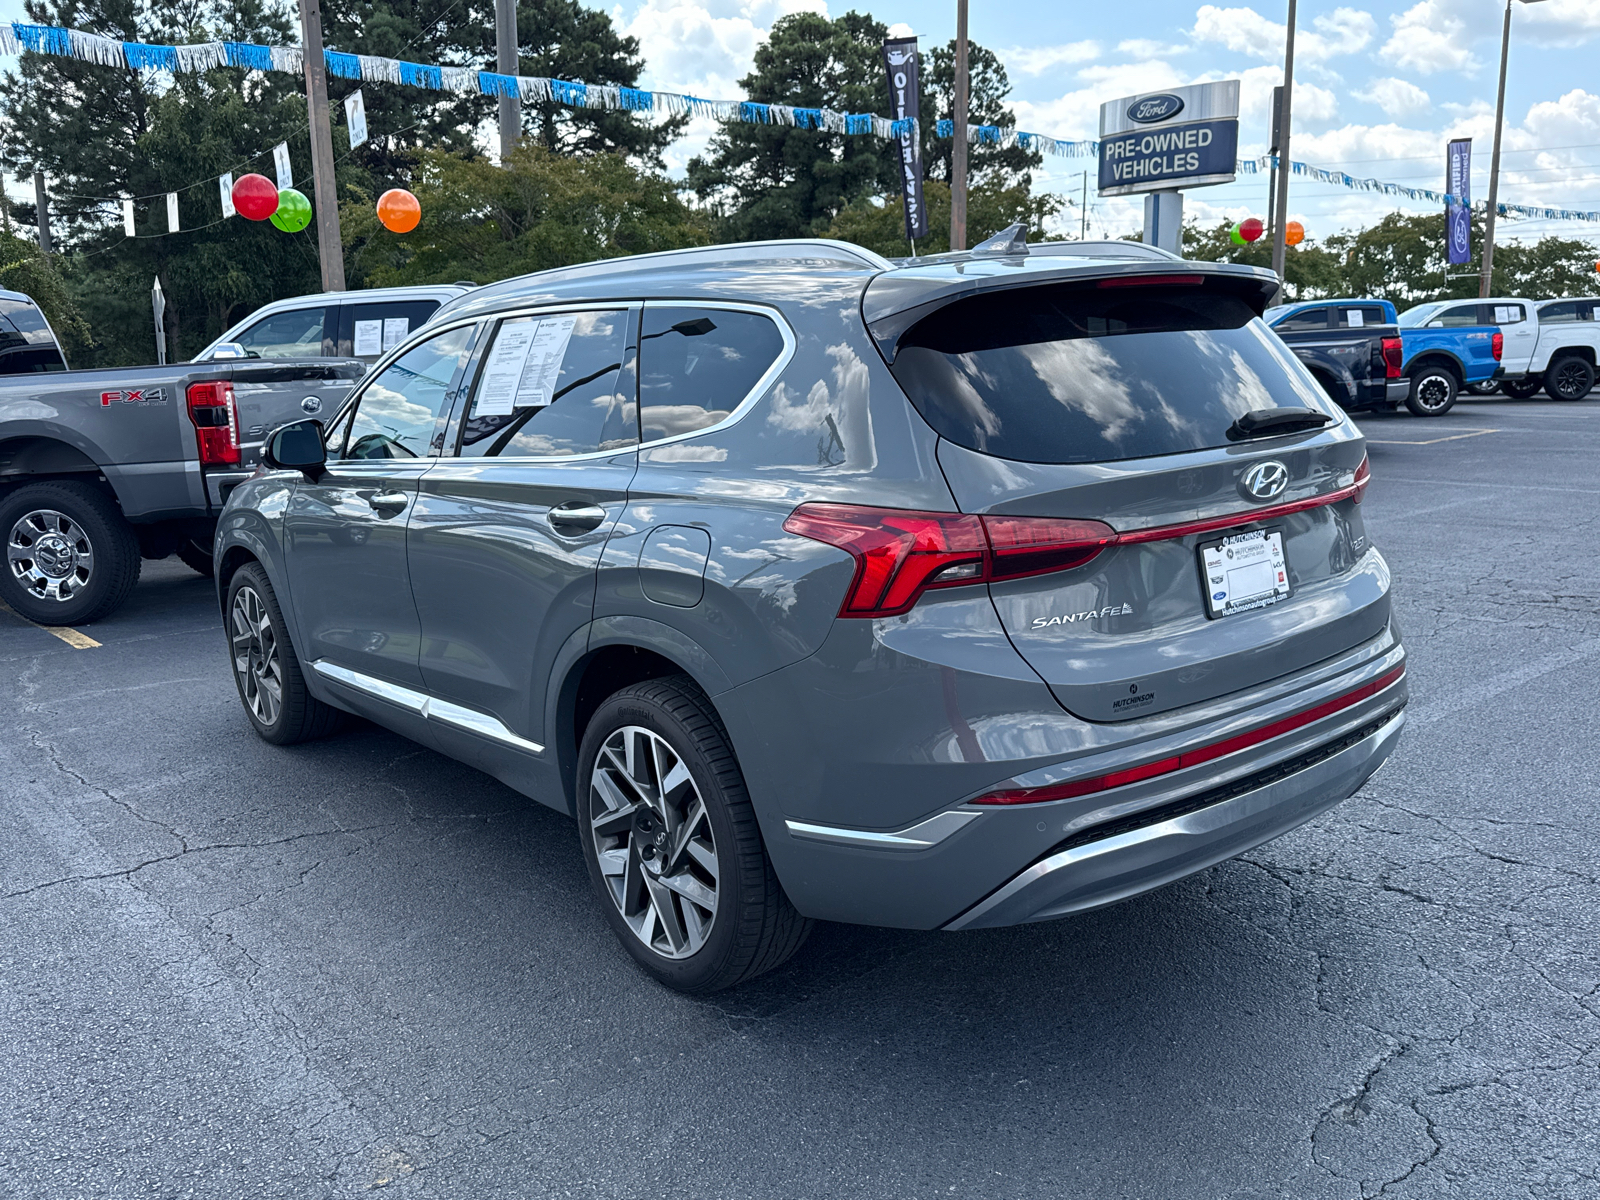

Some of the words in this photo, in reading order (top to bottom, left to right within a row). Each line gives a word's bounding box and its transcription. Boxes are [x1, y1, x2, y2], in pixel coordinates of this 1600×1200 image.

[1136, 100, 1168, 119] Ford
[352, 127, 365, 144] ONLY
[1106, 129, 1212, 160] PRE-OWNED
[1112, 152, 1199, 180] VEHICLES
[100, 387, 168, 408] FX4
[1230, 530, 1266, 545] HUTCHINSON
[1221, 593, 1288, 617] Hutchinsonautogroup.com
[1112, 692, 1155, 709] HUTCHINSON
[1113, 703, 1140, 713] AUTOMOTIVE
